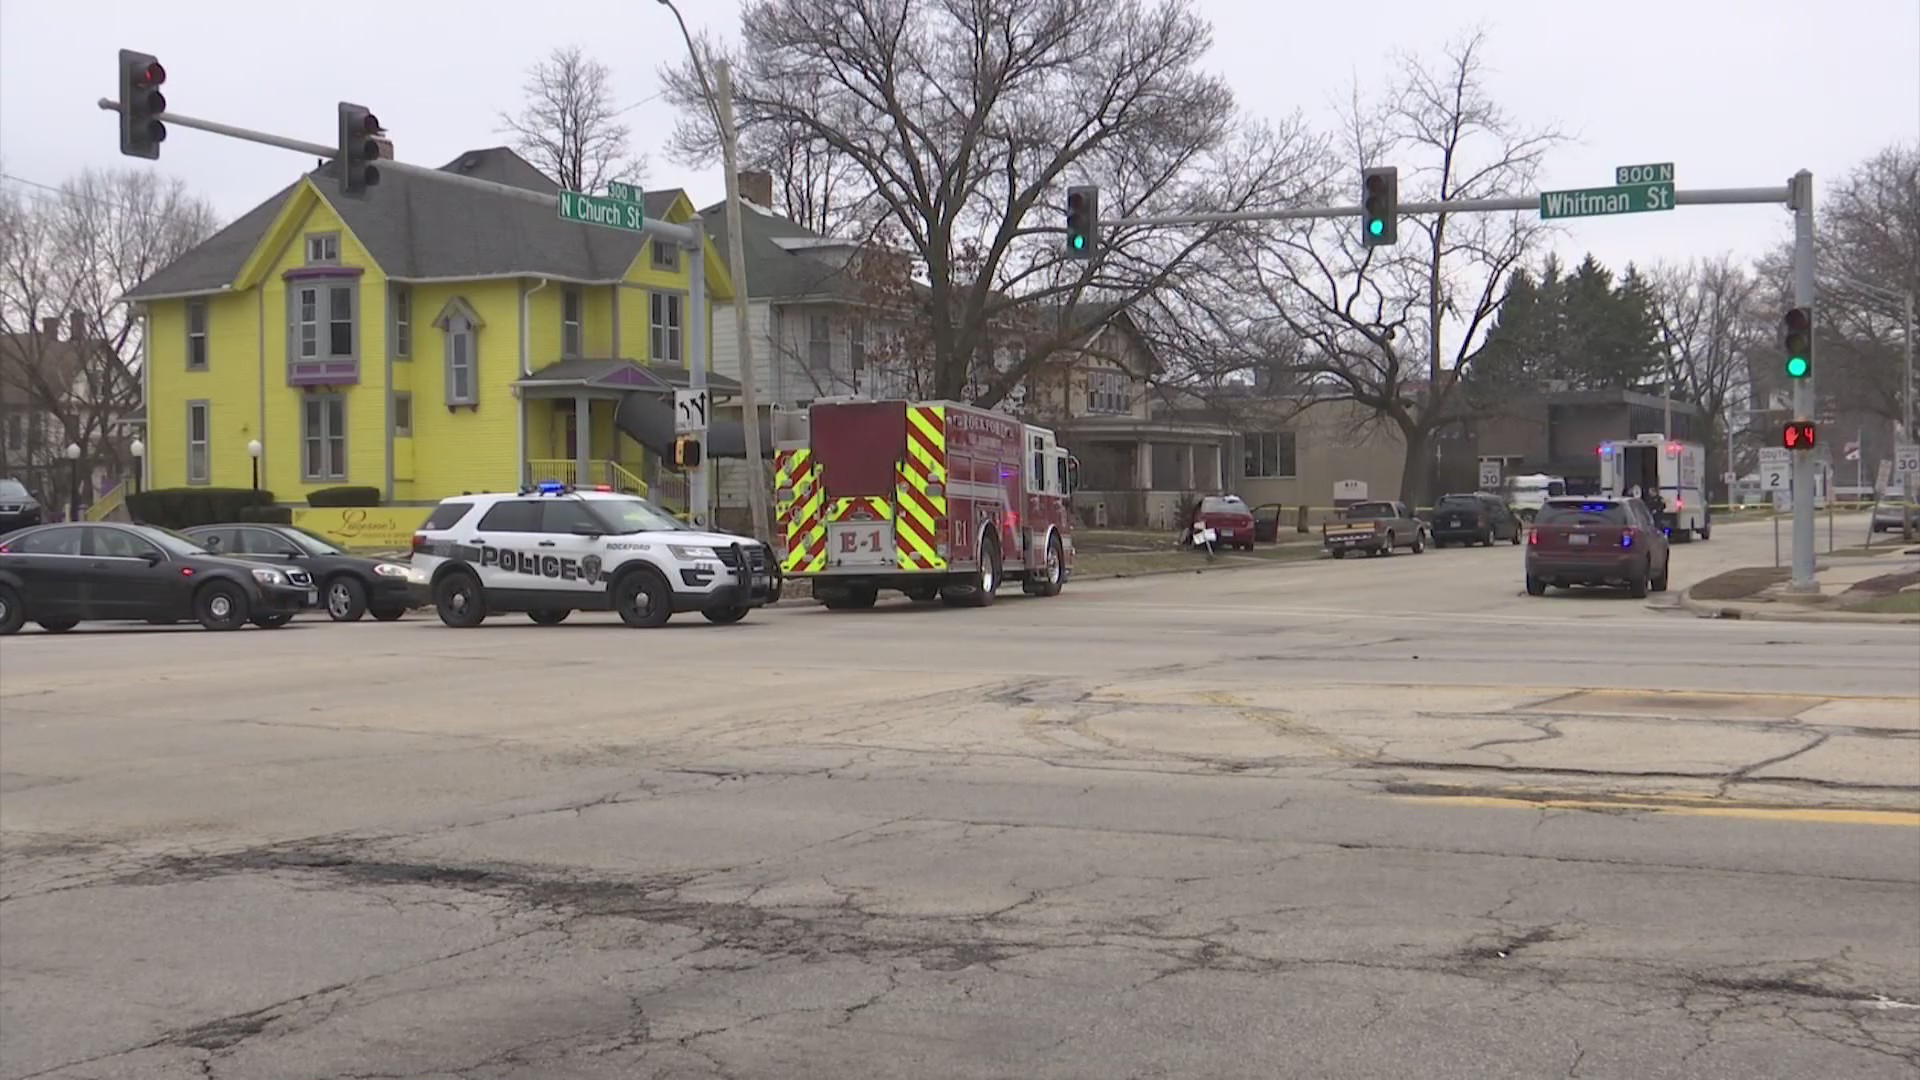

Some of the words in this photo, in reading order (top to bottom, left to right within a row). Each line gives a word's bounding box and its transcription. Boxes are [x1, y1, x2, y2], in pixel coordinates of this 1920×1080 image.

[1618, 166, 1655, 183] 800
[1660, 165, 1672, 181] N
[609, 183, 628, 200] 300
[1545, 192, 1631, 217] Whitman
[1646, 186, 1669, 209] St
[561, 194, 571, 216] N
[577, 197, 621, 225] Church
[627, 205, 641, 229] St
[1804, 427, 1814, 445] 4
[1898, 458, 1918, 470] 30
[1483, 474, 1498, 485] 30
[1770, 472, 1781, 487] 2
[605, 542, 652, 551] ROCKFORD
[839, 529, 883, 553] E-1
[480, 545, 577, 581] POLICE
